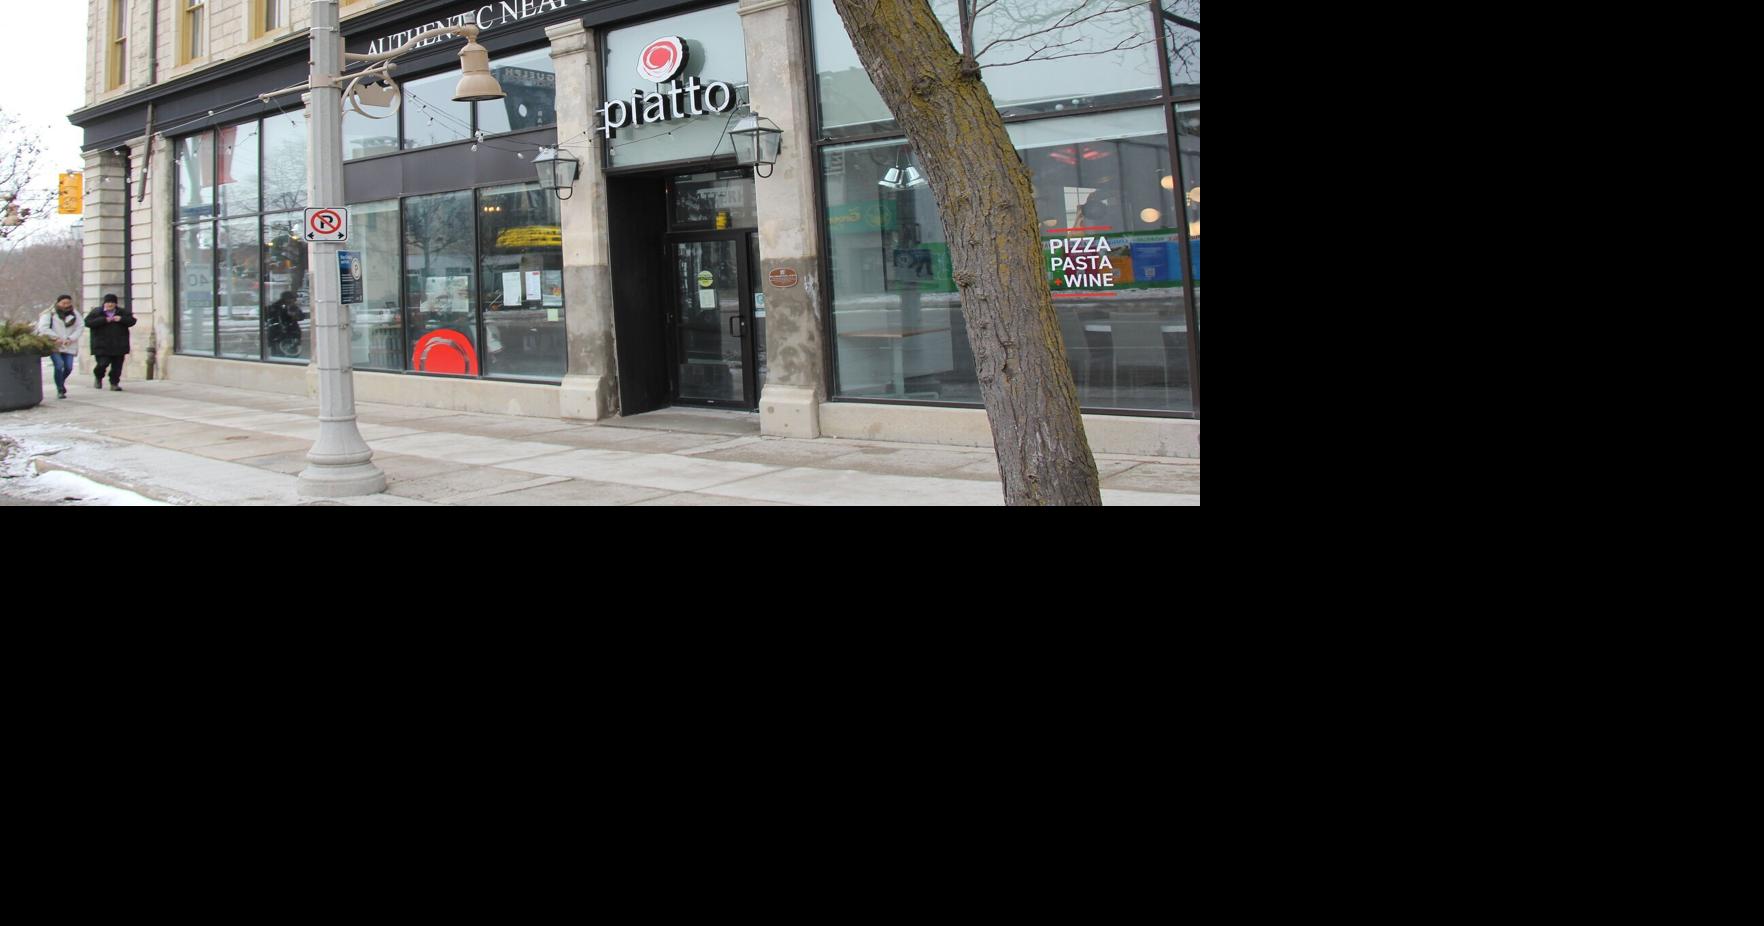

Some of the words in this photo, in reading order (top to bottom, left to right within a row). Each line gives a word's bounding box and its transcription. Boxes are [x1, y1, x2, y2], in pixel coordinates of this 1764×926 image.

[368, 5, 493, 55] AUTHENTC
[603, 76, 733, 138] piatto
[1050, 236, 1112, 255] PIZZA
[1051, 255, 1113, 271] PASTA
